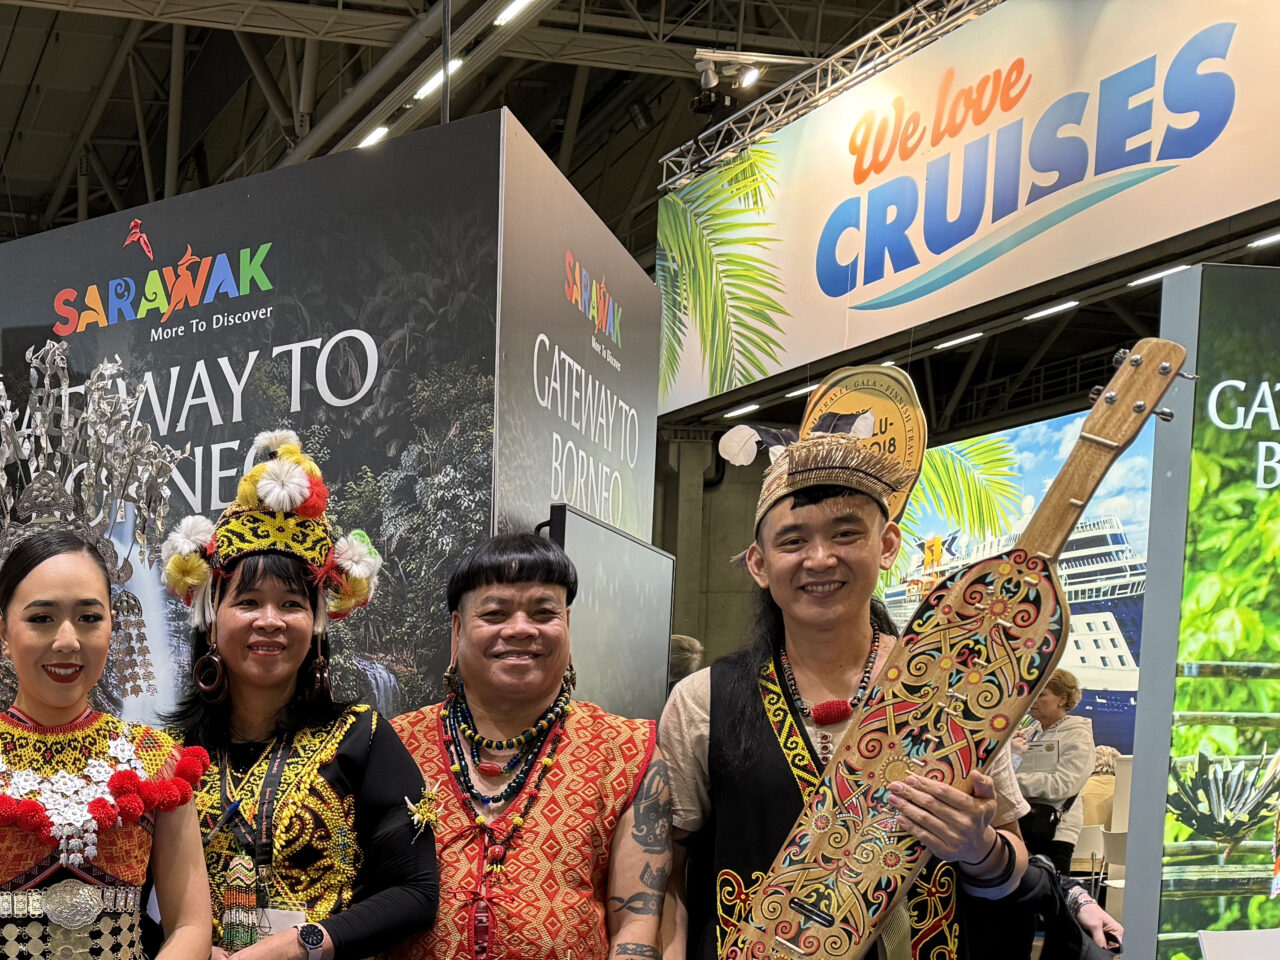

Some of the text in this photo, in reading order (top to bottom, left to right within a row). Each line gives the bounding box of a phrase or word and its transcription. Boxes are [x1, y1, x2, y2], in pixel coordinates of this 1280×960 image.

[815, 22, 1238, 298] CRUISES
[848, 57, 1033, 185] We love
[52, 243, 273, 336] SARAWAK
[150, 307, 273, 342] More To Discover
[565, 250, 622, 349] SARAWAK
[272, 330, 378, 412] TO
[533, 333, 639, 469] GATEWAY TO
[853, 379, 877, 389] GALA
[1208, 379, 1280, 431] GA
[550, 431, 622, 530] BORNEO
